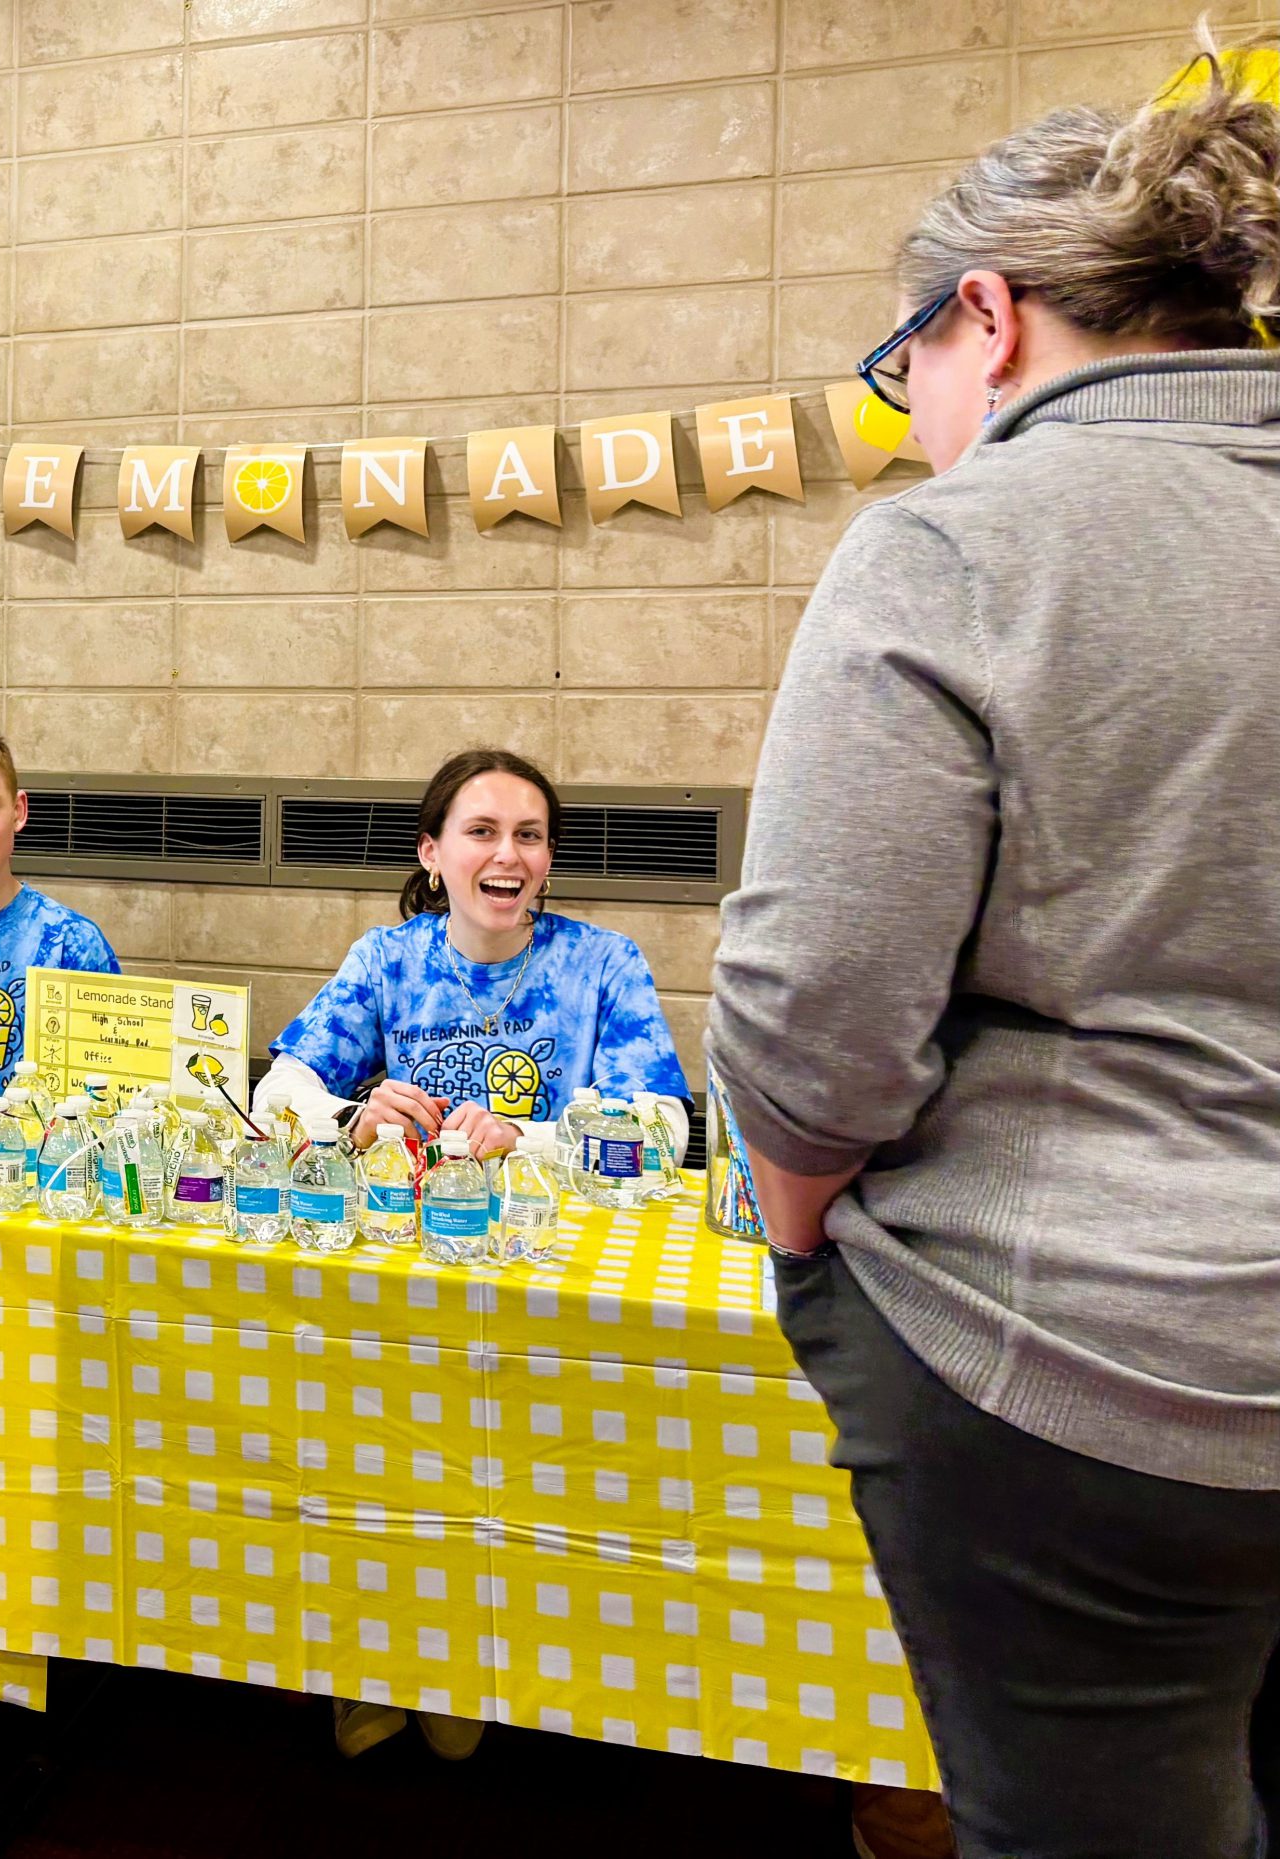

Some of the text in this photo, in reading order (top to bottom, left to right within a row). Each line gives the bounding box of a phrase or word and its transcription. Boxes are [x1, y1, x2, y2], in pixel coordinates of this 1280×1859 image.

[77, 989, 174, 1009] Lemonade Stand
[91, 1013, 144, 1027] High School
[100, 1034, 129, 1047] Learning
[392, 1018, 534, 1044] THE LEARNING PAD
[85, 1051, 112, 1063] Office
[648, 1124, 666, 1157] original
[164, 1151, 182, 1188] original
